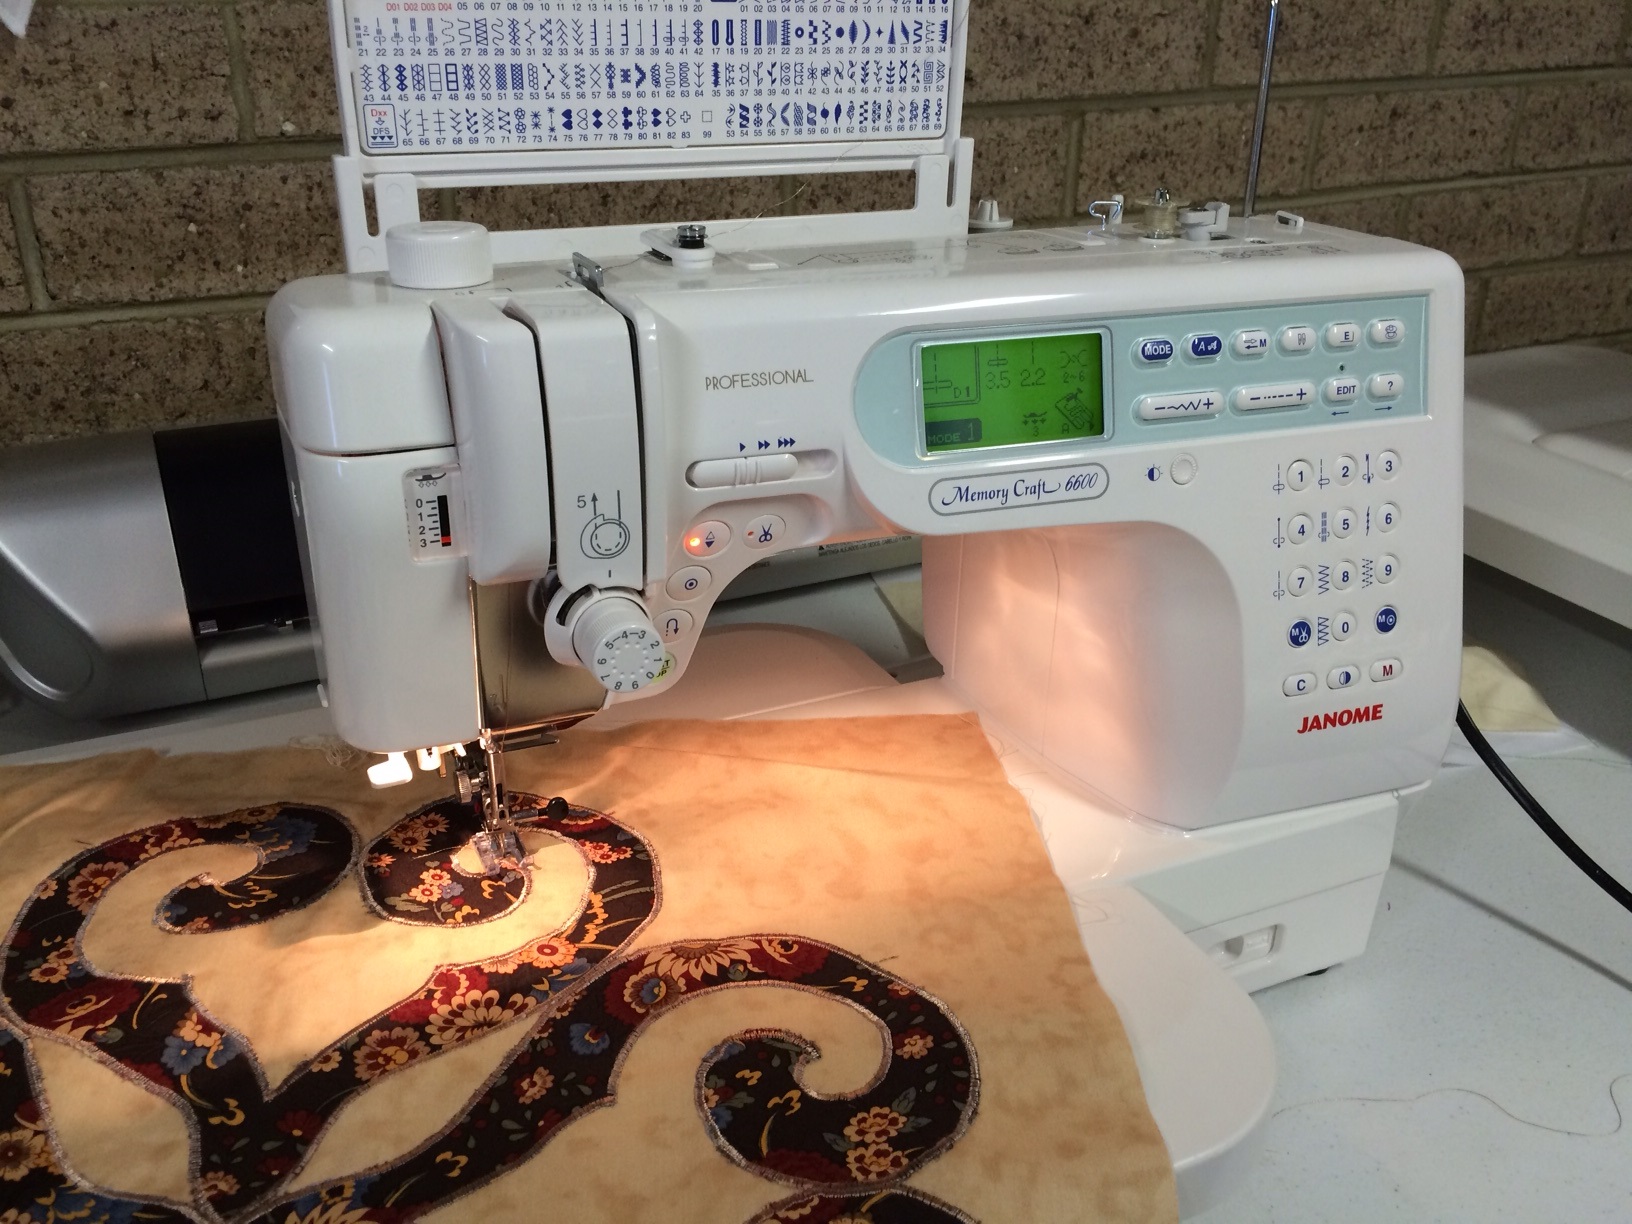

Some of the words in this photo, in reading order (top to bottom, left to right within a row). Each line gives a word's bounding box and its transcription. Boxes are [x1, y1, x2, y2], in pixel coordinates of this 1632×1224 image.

[386, 3, 400, 11] D01
[404, 3, 418, 11] D02
[421, 3, 435, 11] D03
[438, 3, 452, 11] D04
[457, 2, 468, 10] 05
[474, 2, 484, 10] 06
[491, 2, 501, 10] 07
[541, 3, 549, 11] 10
[573, 3, 581, 11] 12
[665, 4, 673, 12] 18
[680, 4, 688, 12] 19
[358, 48, 368, 56] 21
[376, 48, 386, 56] 22
[393, 48, 404, 56] 23
[411, 48, 421, 56] 24
[428, 48, 438, 56] 25
[445, 48, 455, 56] 26
[461, 48, 471, 56] 27
[478, 48, 488, 56] 28
[494, 48, 504, 56] 29
[511, 48, 520, 56] 30
[527, 48, 535, 56] 31
[543, 48, 552, 56] 32
[558, 48, 568, 56] 33
[574, 48, 583, 56] 34
[754, 47, 762, 55] 20
[364, 94, 374, 102] 43
[449, 93, 459, 101] 48
[514, 92, 523, 100] 52
[530, 92, 539, 100] 53
[592, 91, 601, 99] 57
[607, 91, 616, 99] 58
[370, 109, 388, 117] Dxx
[372, 127, 390, 135] DFS
[403, 138, 413, 146] 65
[453, 137, 462, 145] 68
[609, 133, 618, 141] 78
[1344, 331, 1350, 341] E
[1259, 338, 1267, 348] M
[1144, 344, 1172, 356] MODE
[705, 369, 814, 391] PROFESSIONAL
[985, 370, 1011, 389] 3.5
[1020, 367, 1046, 387] 2.2
[1336, 385, 1357, 395] EDIT
[928, 433, 961, 444] MODE
[1385, 460, 1393, 472] 3
[1298, 471, 1304, 482] 1
[1341, 466, 1350, 478] 2
[941, 485, 1009, 505] Memory
[1013, 478, 1062, 500] Craft
[1065, 472, 1099, 492] 6600
[416, 499, 423, 508] 0
[577, 495, 586, 508] 5
[417, 512, 423, 521] 1
[1385, 513, 1392, 525] 6
[418, 526, 426, 535] 2
[1298, 525, 1306, 536] 4
[1342, 519, 1350, 531] 5
[420, 539, 427, 548] 3
[1385, 565, 1392, 576] 9
[1342, 571, 1349, 583] 8
[1297, 577, 1305, 589] 7
[1378, 615, 1386, 623] M
[1291, 628, 1300, 637] M
[1342, 622, 1349, 633] 0
[1383, 665, 1393, 677] M
[1297, 679, 1306, 691] C
[1297, 703, 1384, 734] JANOME
